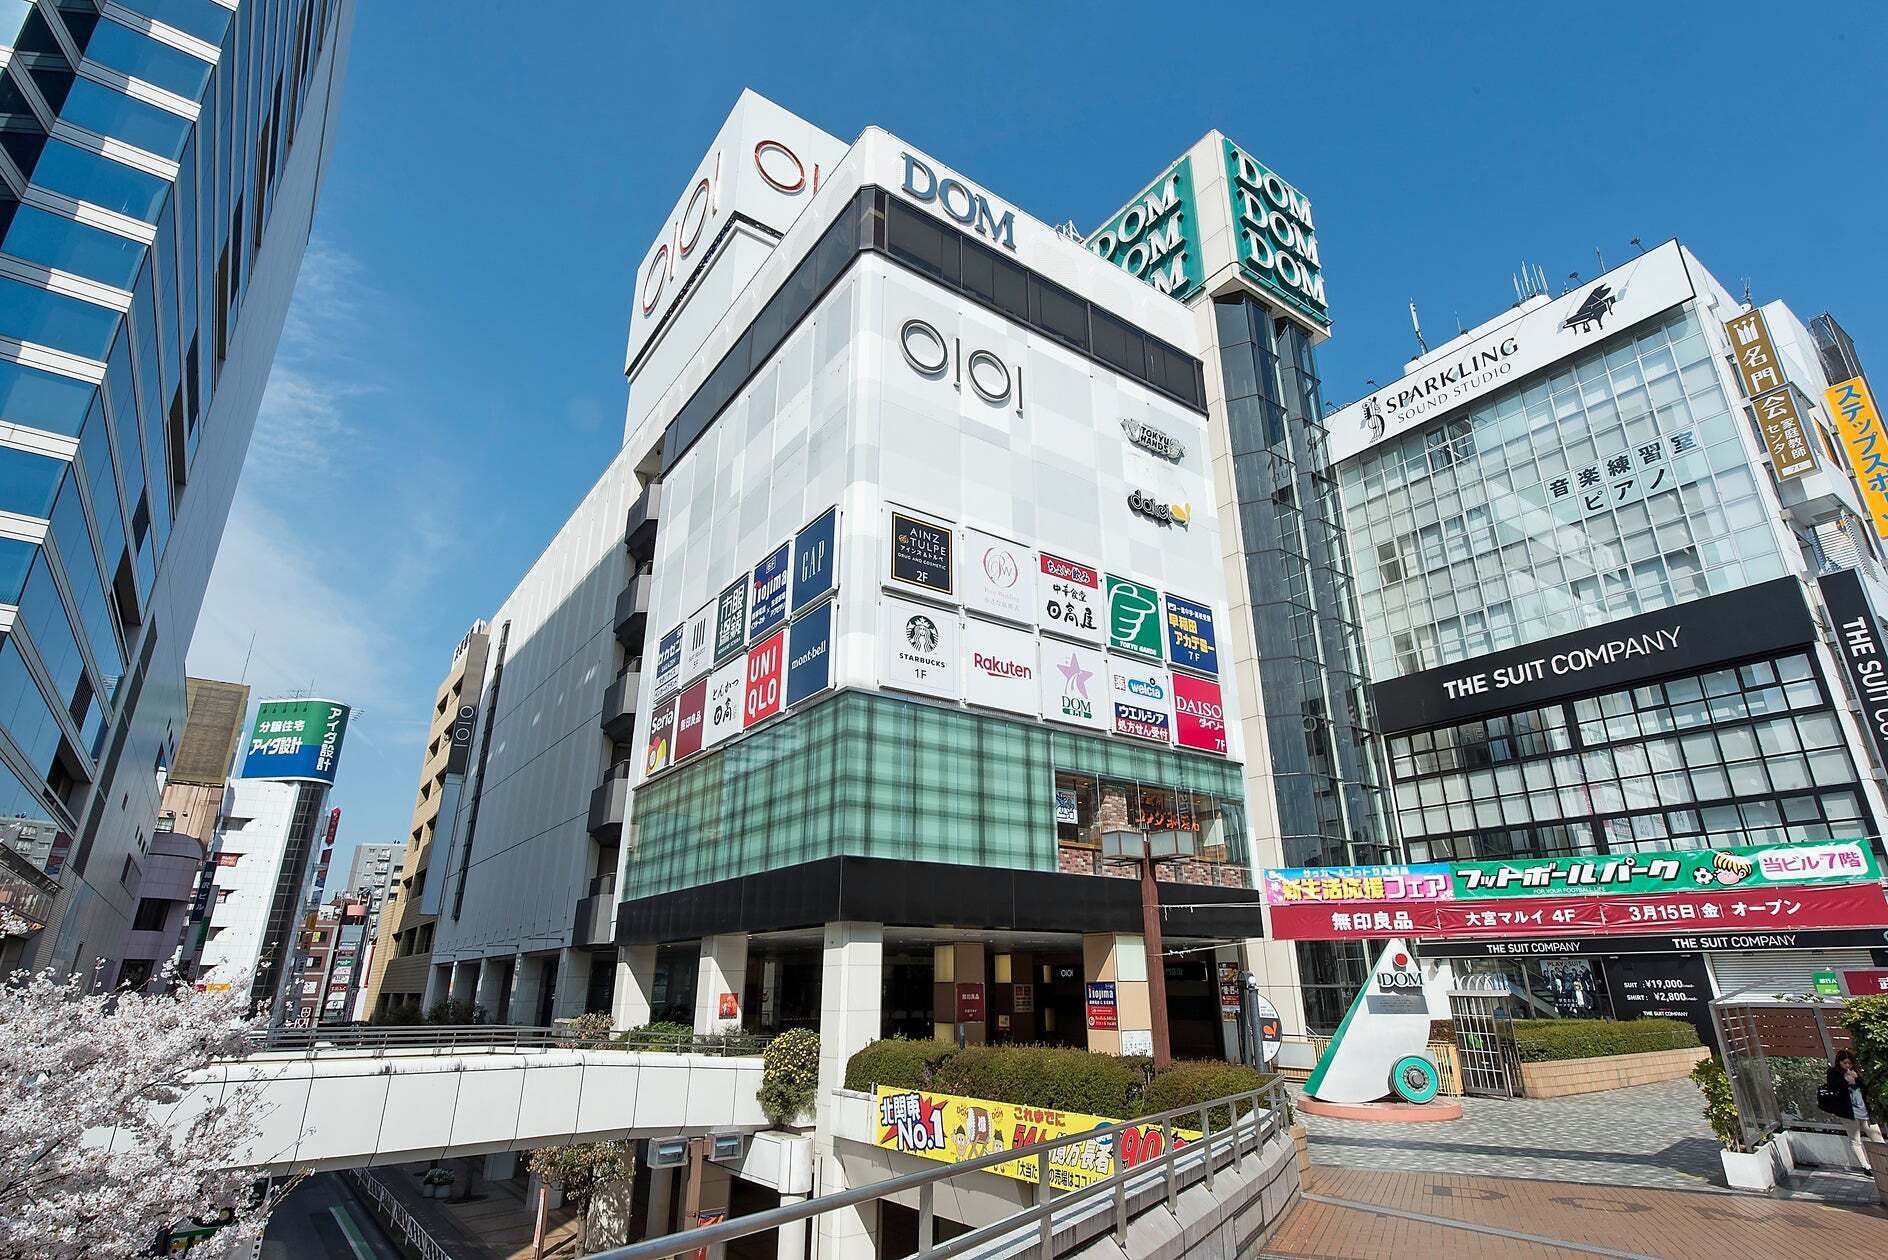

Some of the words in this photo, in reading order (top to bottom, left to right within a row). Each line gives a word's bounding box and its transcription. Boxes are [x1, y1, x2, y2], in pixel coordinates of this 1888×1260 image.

[901, 151, 1017, 253] DOM
[1231, 149, 1316, 231] DOM
[1090, 174, 1184, 261] DOM
[1238, 186, 1322, 270] DOM
[1120, 213, 1187, 278] OM
[1244, 226, 1329, 309] DOM
[1386, 337, 1520, 414] SPARKLING
[1743, 345, 1788, 420] 名門会
[1398, 391, 1448, 424] SOUND
[1453, 362, 1512, 399] STUDIO
[1140, 425, 1170, 446] TOKYU
[1140, 435, 1169, 454] HANDS
[1766, 424, 1787, 463] センター
[1781, 417, 1807, 460] 家庭教師
[1549, 431, 1697, 499] 音楽練習室
[1584, 468, 1665, 511] ピアノ
[909, 537, 947, 557] TULPE
[910, 528, 940, 544] AINZ
[801, 540, 825, 583] GAP
[916, 570, 929, 583] 2F
[1046, 600, 1097, 630] 日高屋
[1168, 613, 1198, 635] 早稲田
[1120, 640, 1138, 652] TOKYU
[1843, 616, 1877, 657] THE
[751, 645, 778, 684] UNI
[791, 640, 827, 671] mont-bell
[899, 652, 946, 668] STARBUCKS
[974, 652, 1032, 680] Rakuten
[1443, 673, 1489, 701] THE
[1494, 657, 1547, 690] SUIT
[1550, 624, 1683, 677] COMPANY
[914, 669, 927, 680] 1F
[1130, 678, 1162, 698] welcia
[711, 678, 740, 702] とんかつ
[748, 677, 778, 718] QLO
[1061, 695, 1092, 713] DOM
[1119, 705, 1165, 724] ウエルシア
[1176, 695, 1222, 719] DAISO
[651, 706, 675, 735] Seria
[680, 709, 703, 733] 無印良品
[1117, 718, 1169, 741] 処方せん受付
[1199, 718, 1224, 731] ダイソー
[248, 736, 304, 756] アイダ設計
[316, 707, 343, 772] アイダ設計
[1215, 738, 1226, 751] 7F
[1456, 857, 1682, 889] フットボールパーク
[1762, 851, 1862, 875] 当ビル7階
[1282, 874, 1448, 901] 新生活応援フェア
[1331, 910, 1414, 931] 無印良品
[1464, 909, 1544, 928] 大宮マルイ
[1552, 907, 1576, 924] 4F
[1730, 899, 1802, 917] オープン
[1486, 943, 1507, 955] THE
[1508, 943, 1530, 954] SUIT
[1531, 941, 1580, 953] COMPANY
[1671, 937, 1698, 950] THE
[1701, 935, 1732, 949] SUIT
[1733, 934, 1797, 948] COMPANY
[1377, 972, 1424, 989] DOM
[1653, 992, 1686, 1002] ¥2,800
[880, 1093, 921, 1126] 北関東
[1014, 1107, 1067, 1128] これまでに
[897, 1108, 946, 1152] No.1
